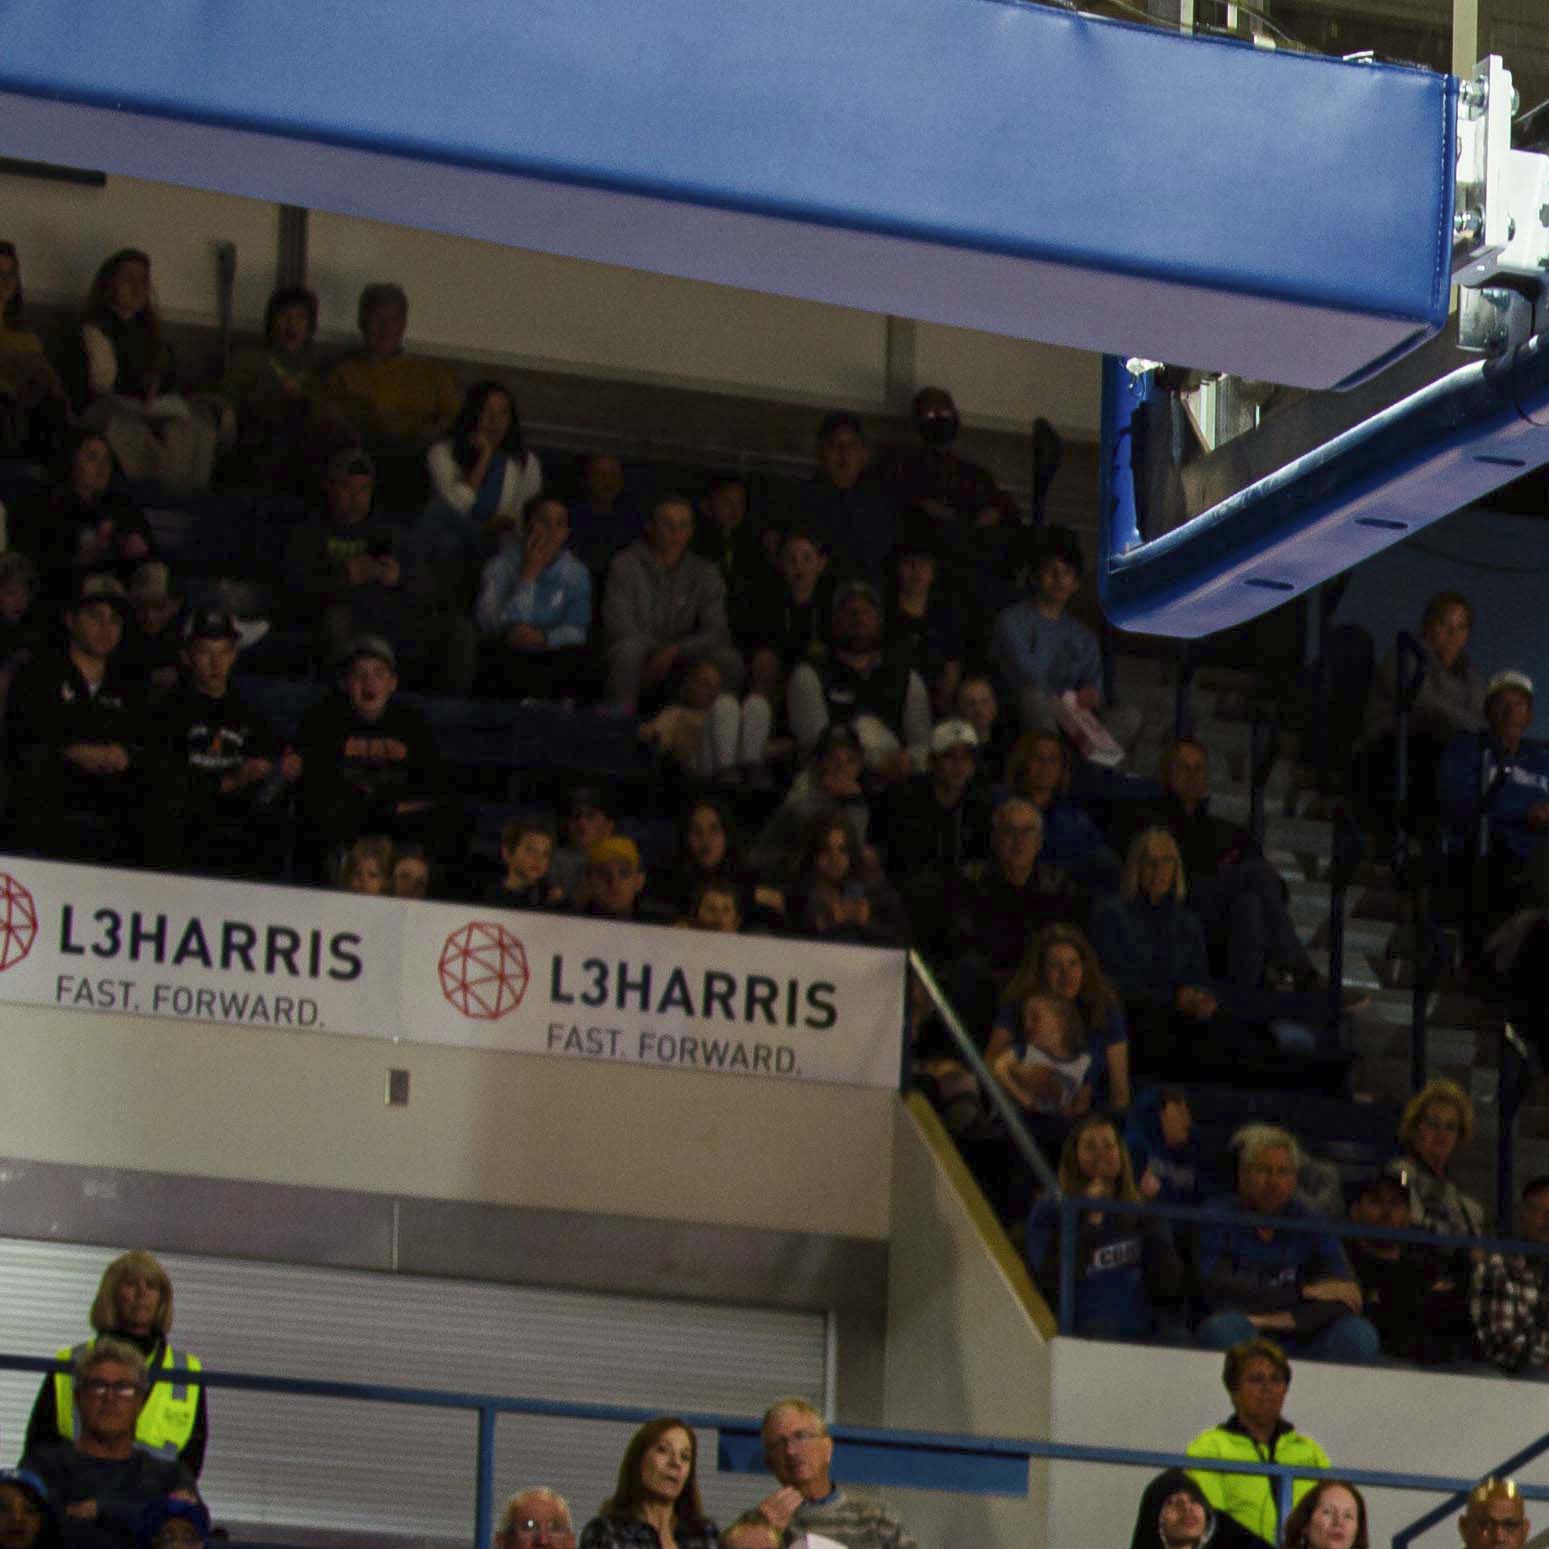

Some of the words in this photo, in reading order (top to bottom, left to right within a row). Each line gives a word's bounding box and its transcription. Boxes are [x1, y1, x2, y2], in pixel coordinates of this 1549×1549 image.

[59, 903, 363, 982] L3HARRIS
[56, 974, 140, 1012] FAST.
[152, 984, 325, 1029] FORWARD.
[550, 953, 839, 1031] L3HARRIS
[547, 1022, 625, 1056] FAST.
[639, 1031, 801, 1076] FORWARD.
